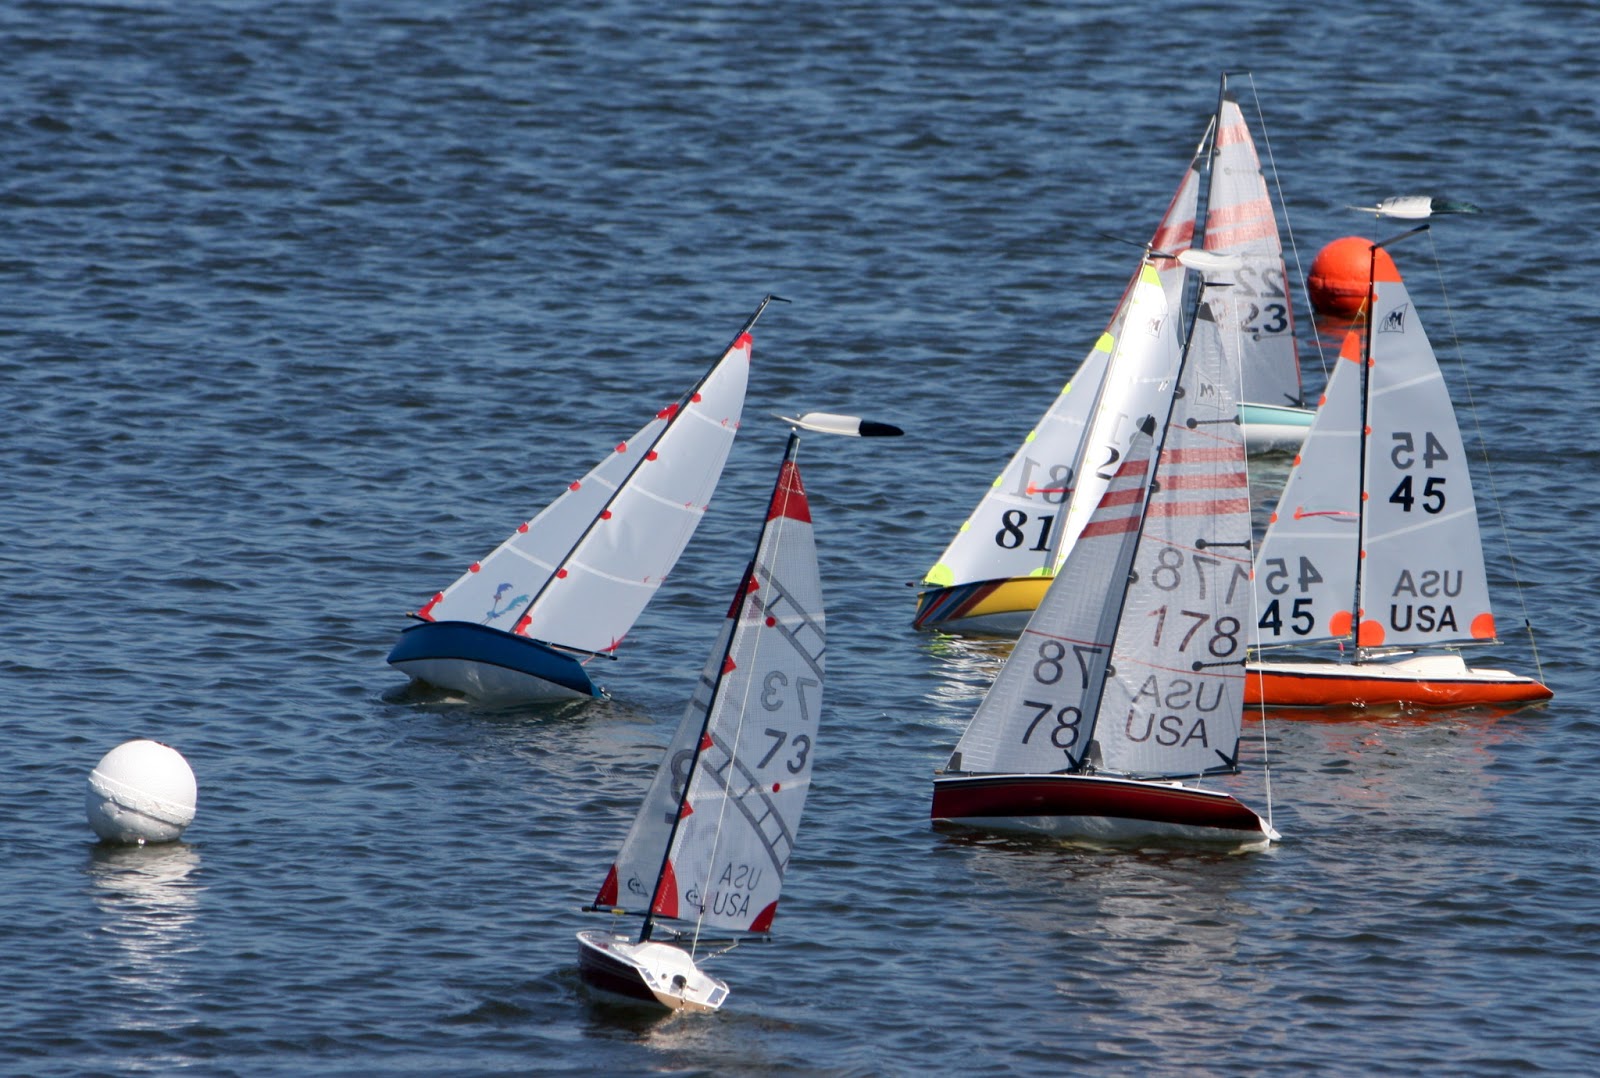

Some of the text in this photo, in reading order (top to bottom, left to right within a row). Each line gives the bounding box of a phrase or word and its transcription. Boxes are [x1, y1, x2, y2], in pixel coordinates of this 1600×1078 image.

[1389, 475, 1446, 514] 45
[995, 509, 1054, 552] 81
[1147, 605, 1240, 658] 178
[1258, 598, 1315, 636] 45
[1390, 604, 1458, 632] USA
[1022, 699, 1082, 748] 78
[1124, 709, 1208, 748] USA
[757, 728, 811, 774] 73
[713, 891, 750, 917] USA
